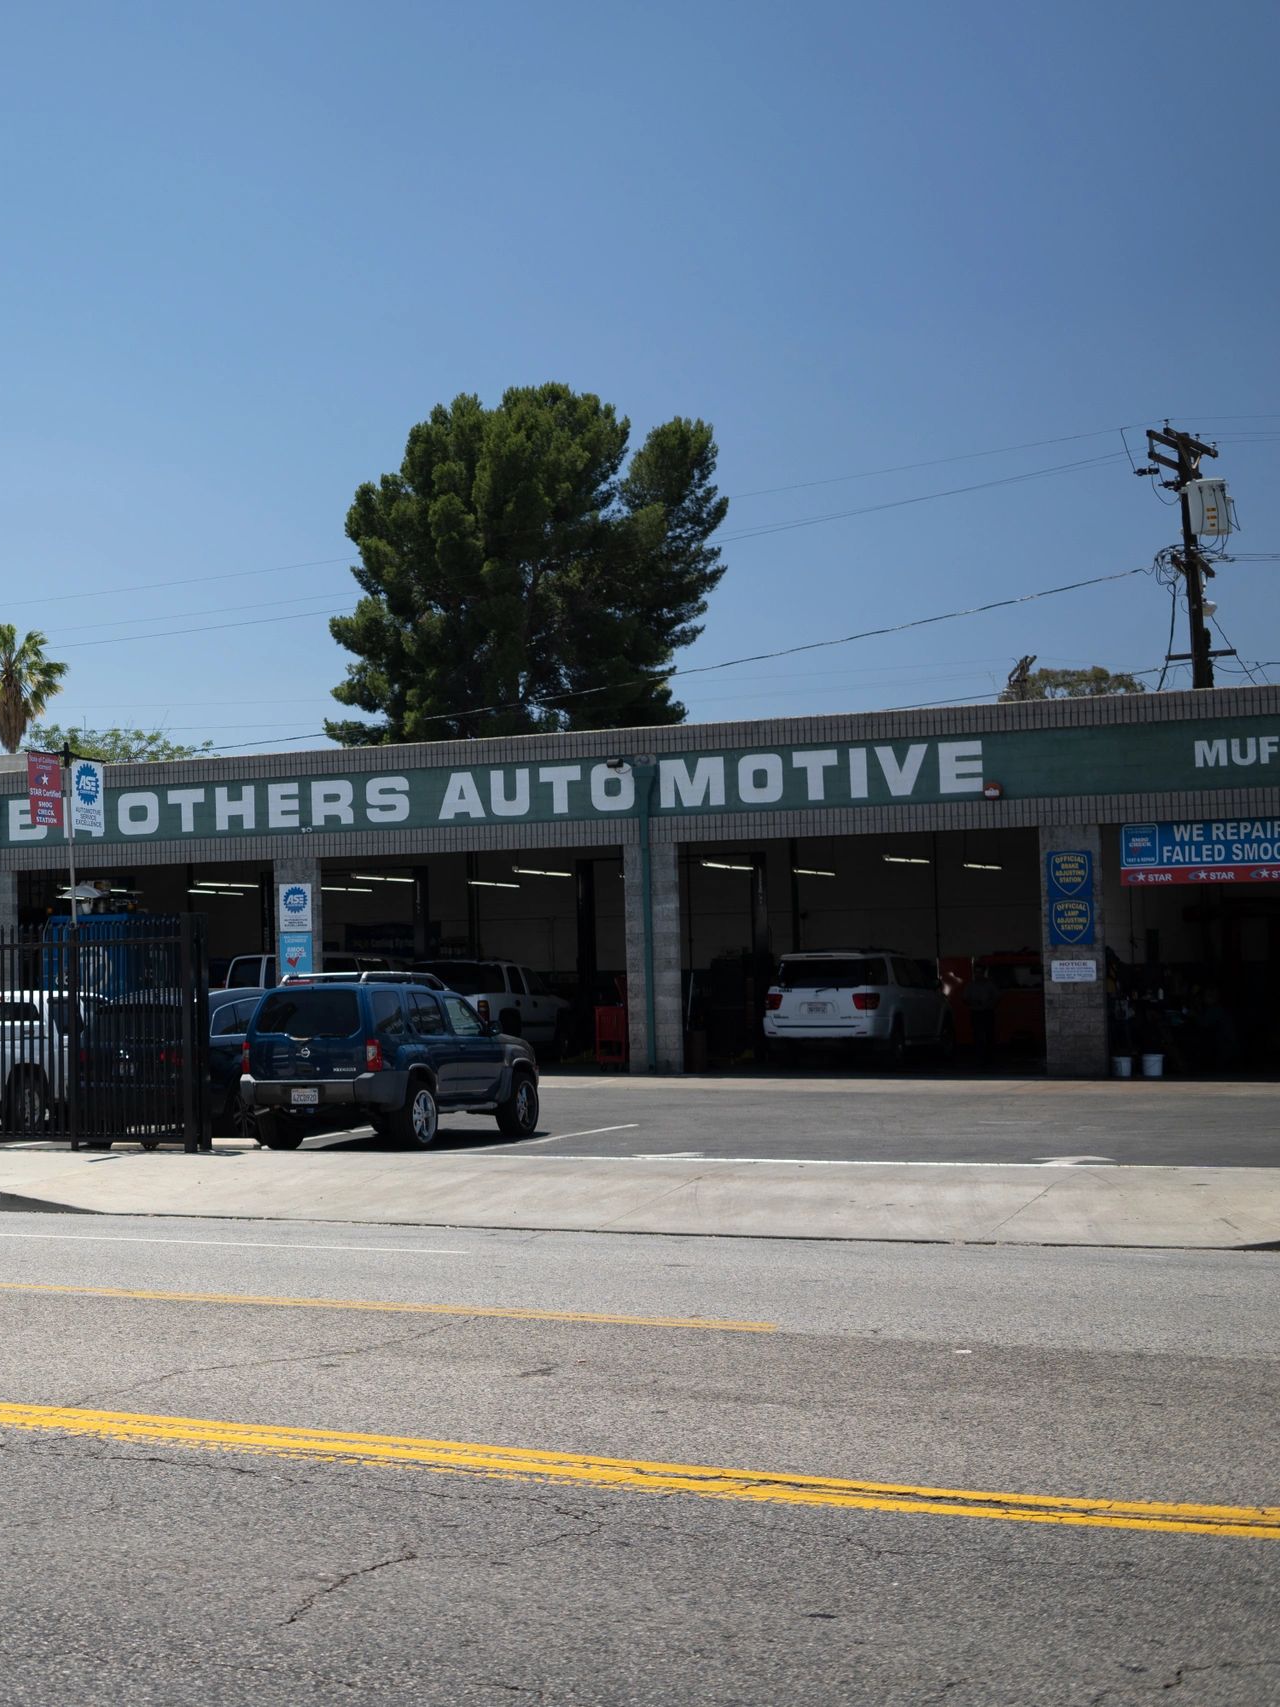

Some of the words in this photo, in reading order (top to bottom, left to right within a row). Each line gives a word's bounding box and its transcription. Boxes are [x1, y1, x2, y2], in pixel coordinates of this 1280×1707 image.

[79, 775, 96, 791] ASE
[29, 787, 42, 796] STAR
[37, 808, 55, 816] CHECK
[75, 807, 102, 816] AUTOMOTIVE
[75, 819, 102, 828] EXCELLENCE
[1173, 823, 1204, 842] WE
[1163, 844, 1226, 863] FAILED
[1055, 855, 1085, 864] OFFICIAL
[1148, 873, 1172, 882] STAR
[1210, 871, 1235, 880] STAR
[286, 894, 304, 905] ASE
[1057, 903, 1087, 911] OFFICIAL
